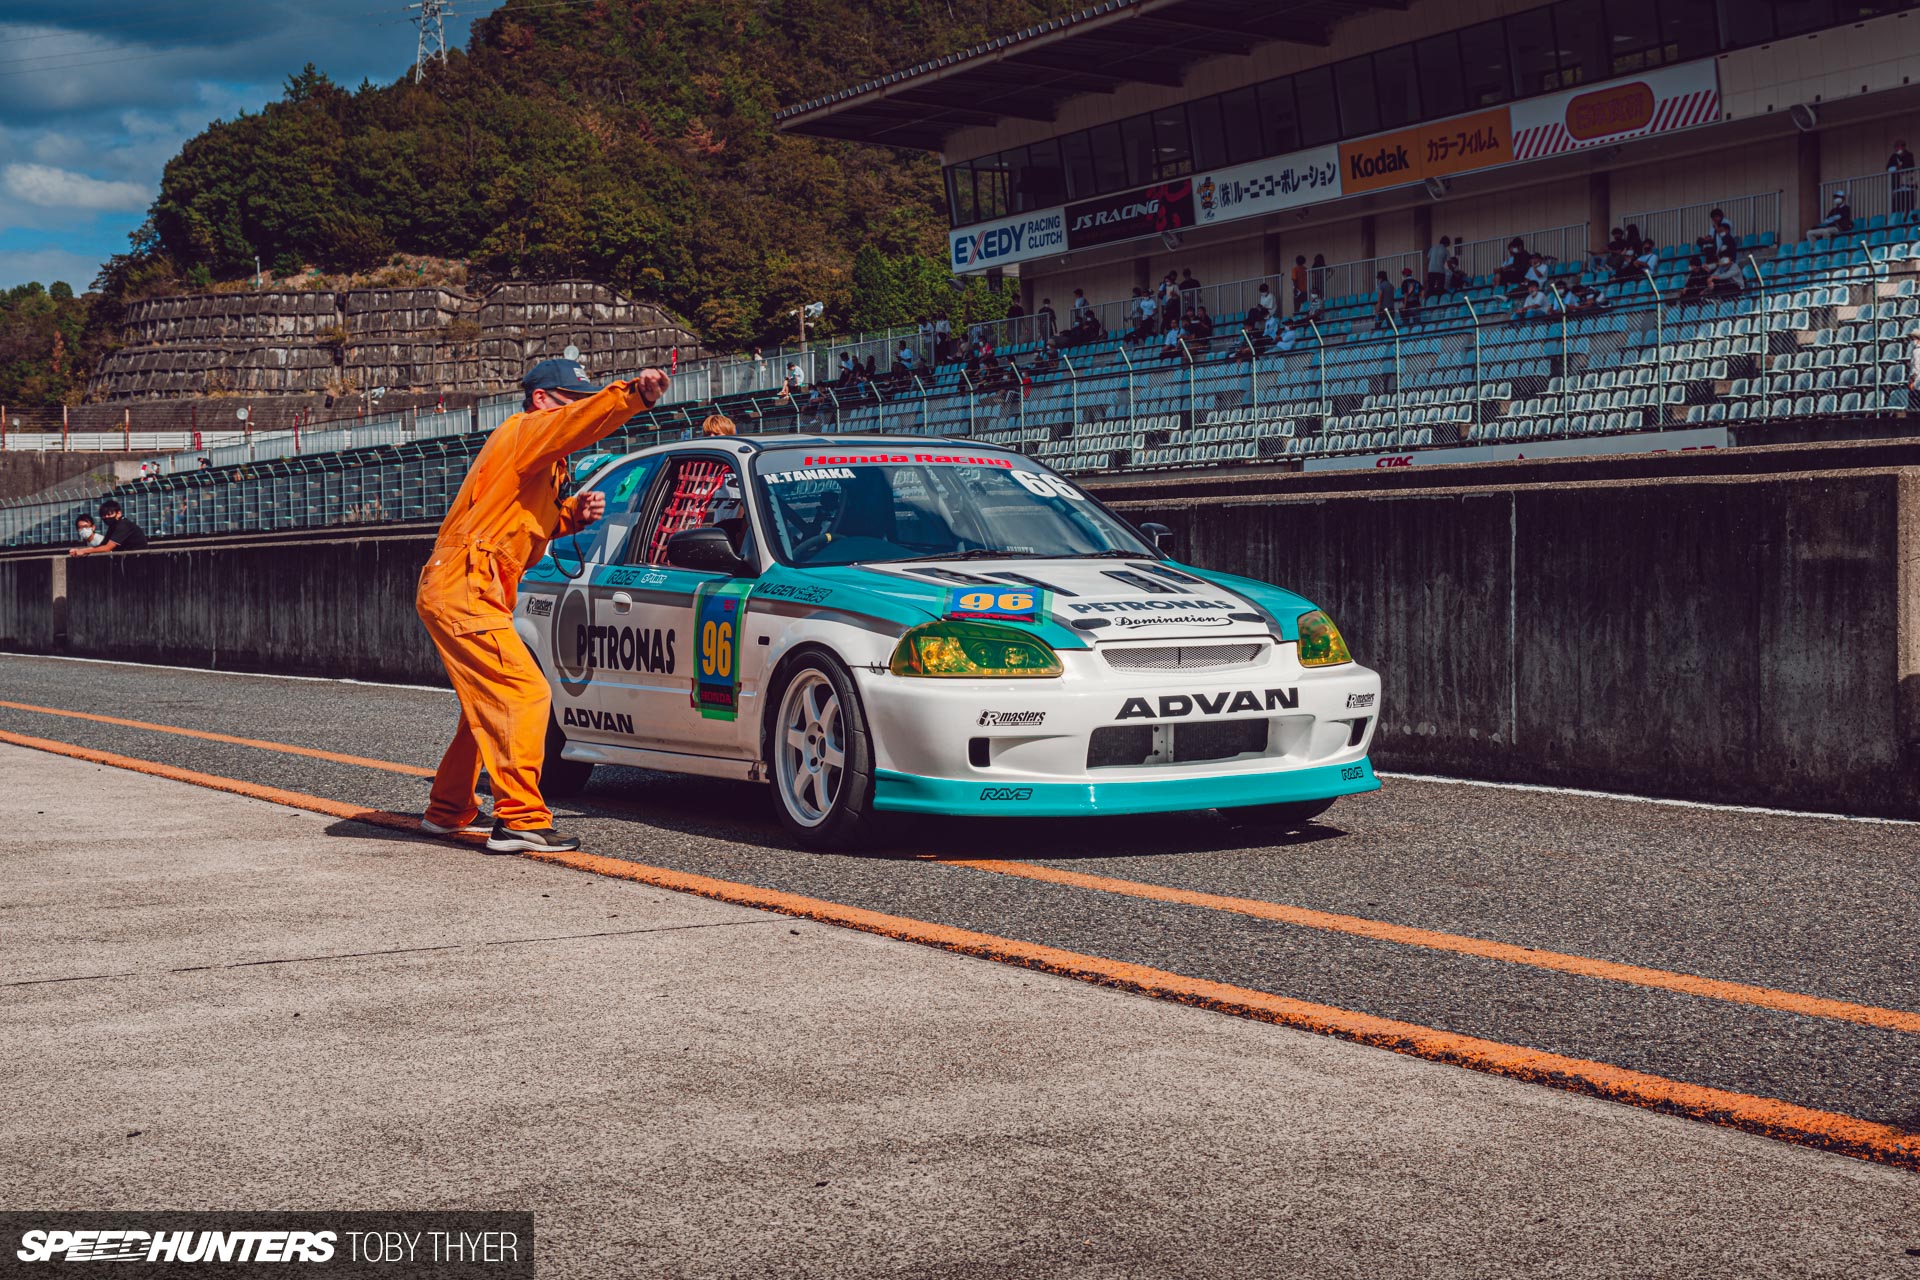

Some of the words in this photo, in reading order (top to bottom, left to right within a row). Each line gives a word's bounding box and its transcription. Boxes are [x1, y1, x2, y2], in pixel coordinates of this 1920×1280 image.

[1427, 126, 1499, 163] カラーフィルム
[1350, 144, 1410, 180] Kodak
[1095, 199, 1159, 226] RACING
[1028, 215, 1061, 234] RACING
[954, 222, 1026, 265] EXEDY
[1028, 230, 1063, 249] CLUTCH
[804, 454, 909, 466] Honda
[914, 454, 1013, 469] Racing
[763, 468, 856, 485] N.TANAKA
[1010, 470, 1085, 500] 66
[606, 569, 641, 586] RAYS
[754, 582, 799, 598] MUGEN
[959, 592, 1034, 611] 96
[1068, 599, 1236, 614] PETRONAS
[1114, 614, 1234, 629] Domination
[576, 624, 676, 675] PETRONAS
[702, 620, 733, 678] 96
[1114, 687, 1299, 720] ADVAN
[563, 707, 635, 735] ADVAN
[1341, 766, 1364, 781] RAYS
[980, 787, 1033, 801] RAYS
